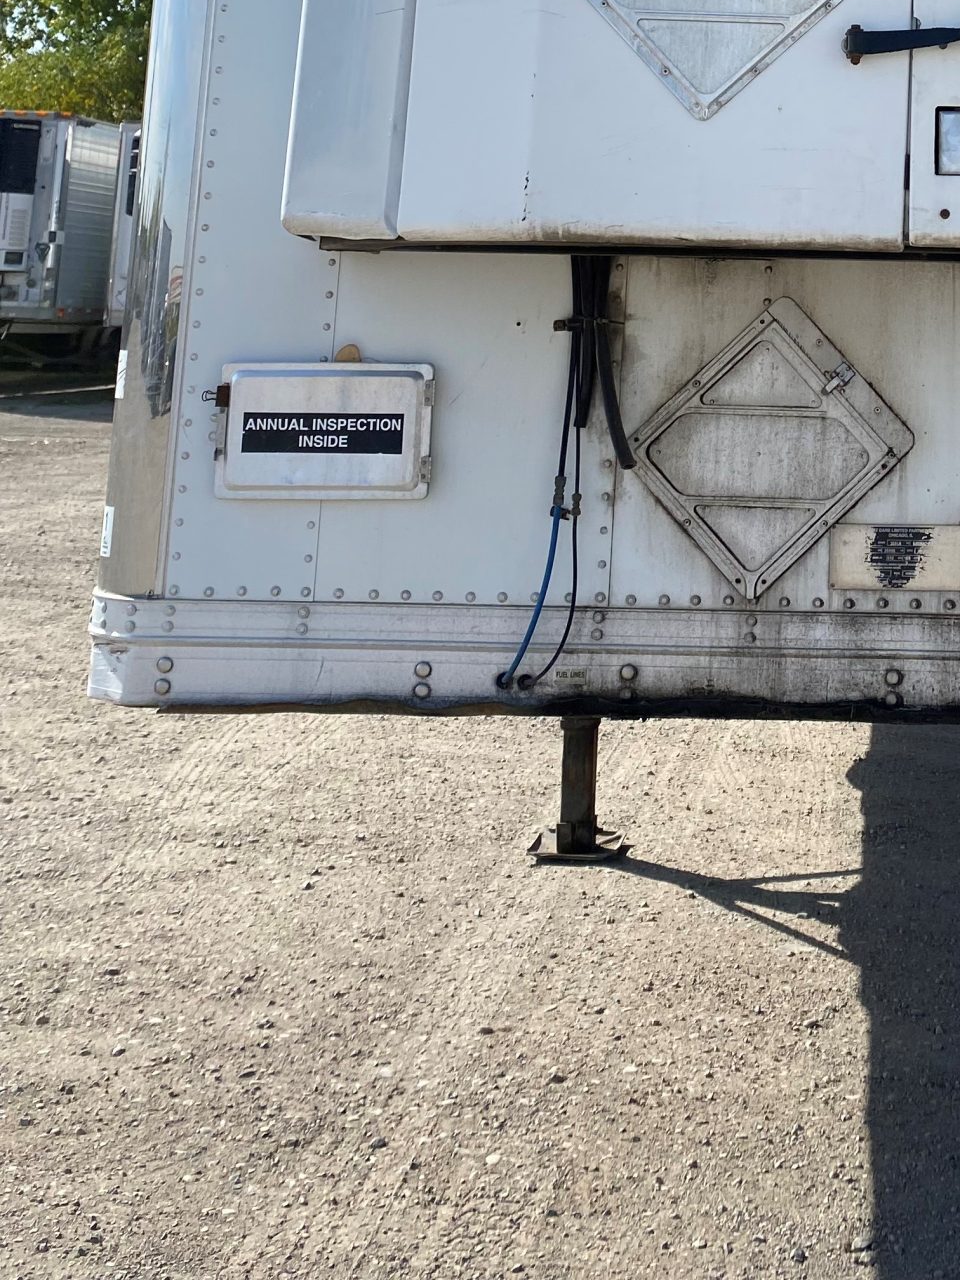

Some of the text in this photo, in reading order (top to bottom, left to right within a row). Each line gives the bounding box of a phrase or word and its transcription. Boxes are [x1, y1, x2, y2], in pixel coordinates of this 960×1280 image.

[245, 418, 401, 431] ANNUAL INSPECTION
[298, 435, 348, 447] INSIDE
